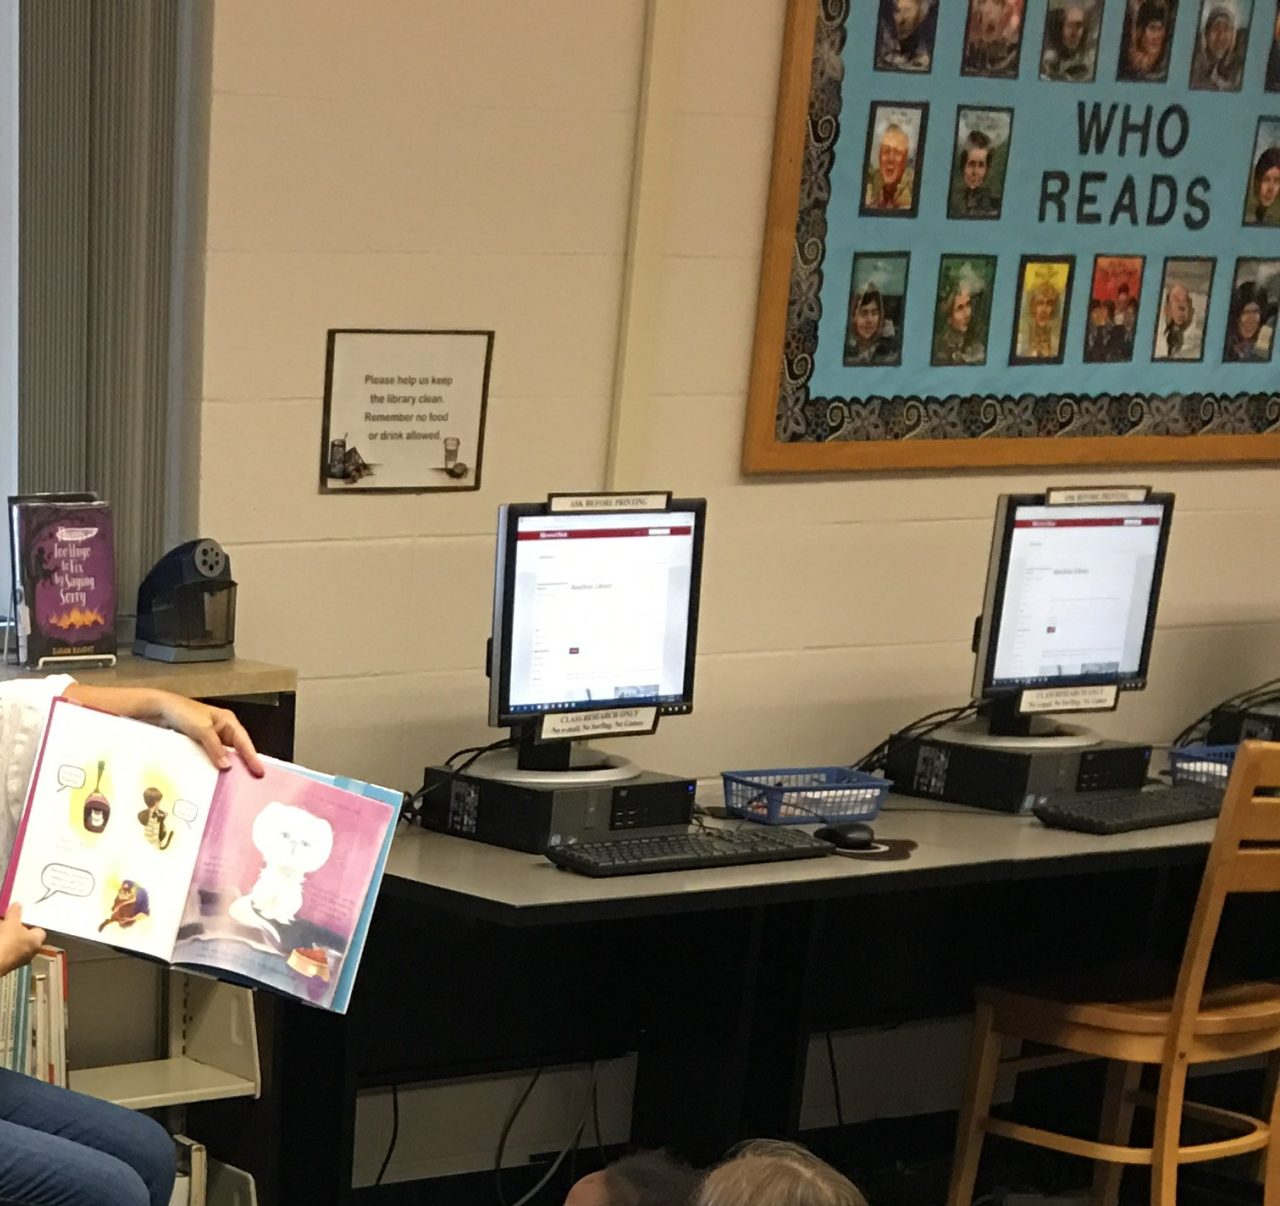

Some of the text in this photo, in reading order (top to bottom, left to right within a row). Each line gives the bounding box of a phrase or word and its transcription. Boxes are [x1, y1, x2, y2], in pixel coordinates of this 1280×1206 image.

[1077, 101, 1190, 159] WHO
[1038, 170, 1211, 231] READS
[365, 375, 453, 387] Please help us keep
[370, 394, 445, 405] the library clean.
[365, 412, 449, 422] Remember no food
[368, 432, 379, 440] or
[380, 431, 403, 440] drink
[70, 544, 91, 561] Huge
[65, 576, 95, 590] Saying
[60, 589, 86, 606] Sorry
